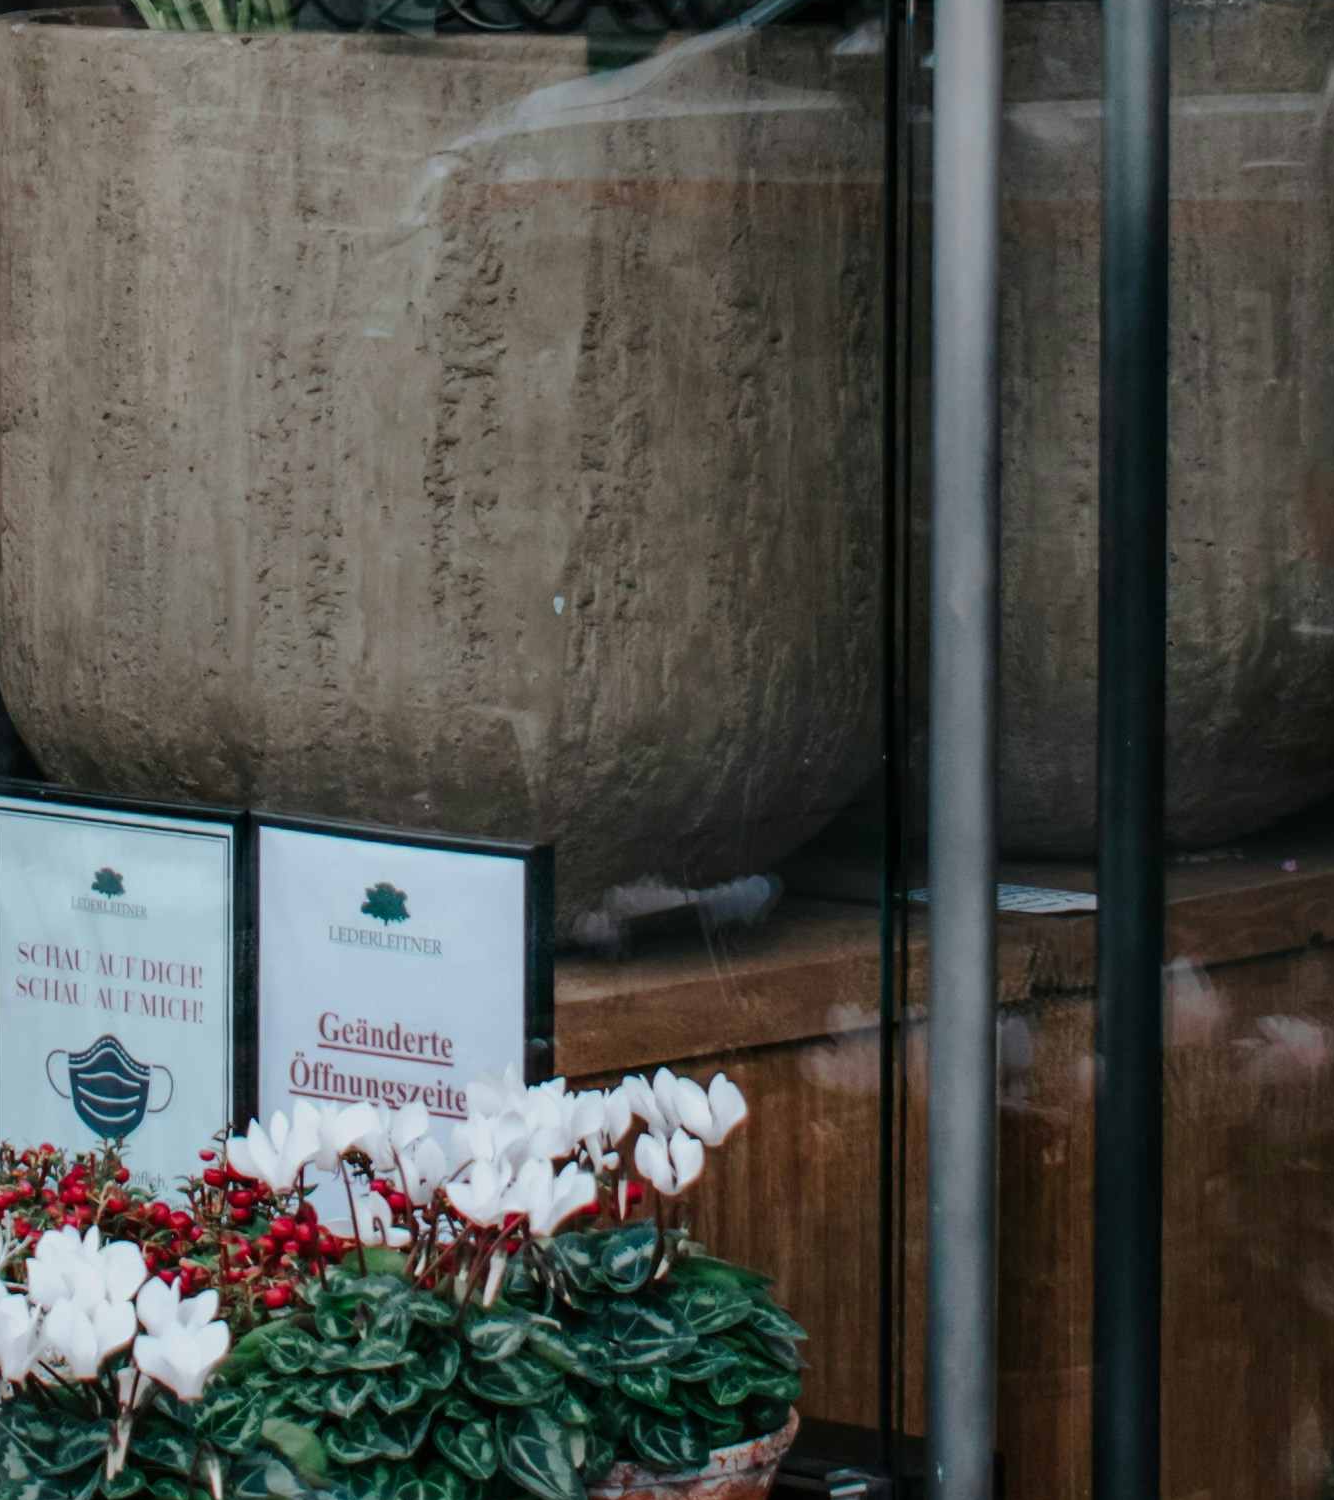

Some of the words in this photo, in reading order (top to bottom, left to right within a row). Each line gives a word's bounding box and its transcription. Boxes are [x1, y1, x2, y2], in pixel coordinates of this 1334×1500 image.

[70, 896, 148, 920] LEDERLEITNER
[328, 924, 444, 956] LEDERLEITNER
[16, 941, 90, 973] SCHAU
[95, 952, 137, 981] AUF
[142, 958, 204, 990] DICH!
[15, 974, 88, 1007] SCHAU
[93, 985, 135, 1014] AUF
[139, 992, 204, 1025] MICH!
[318, 1011, 454, 1060] Geänderte
[289, 1051, 467, 1113] Öffnungszeite
